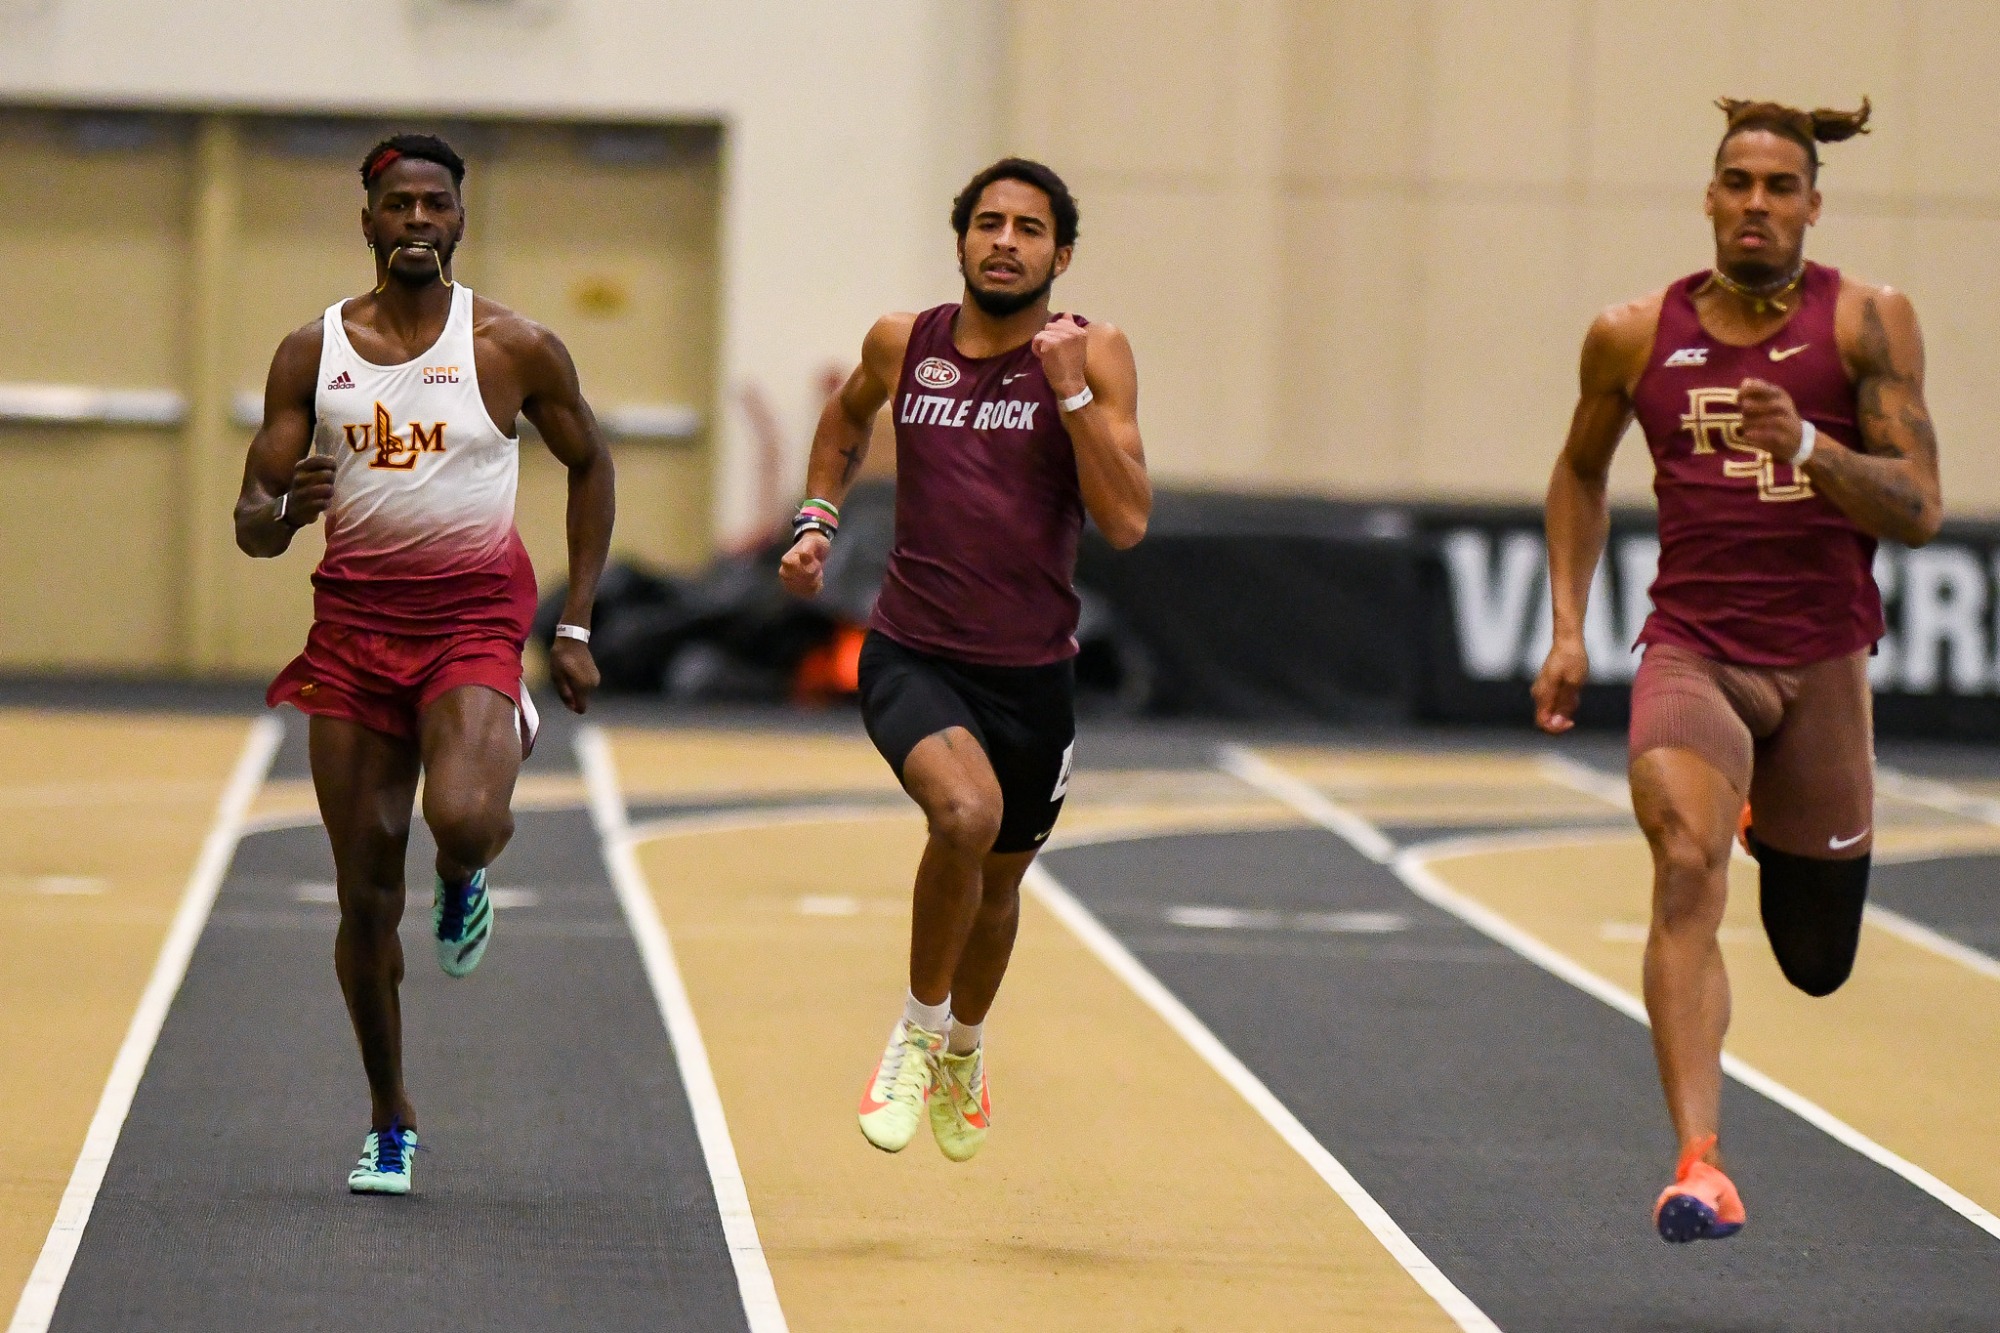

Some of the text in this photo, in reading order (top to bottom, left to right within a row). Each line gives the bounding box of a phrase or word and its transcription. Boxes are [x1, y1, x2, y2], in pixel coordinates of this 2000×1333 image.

[423, 366, 460, 385] SBC
[923, 366, 950, 381] OVC
[327, 382, 356, 390] adidas
[900, 393, 1040, 431] LITTLE ROCK
[343, 400, 447, 471] ULM
